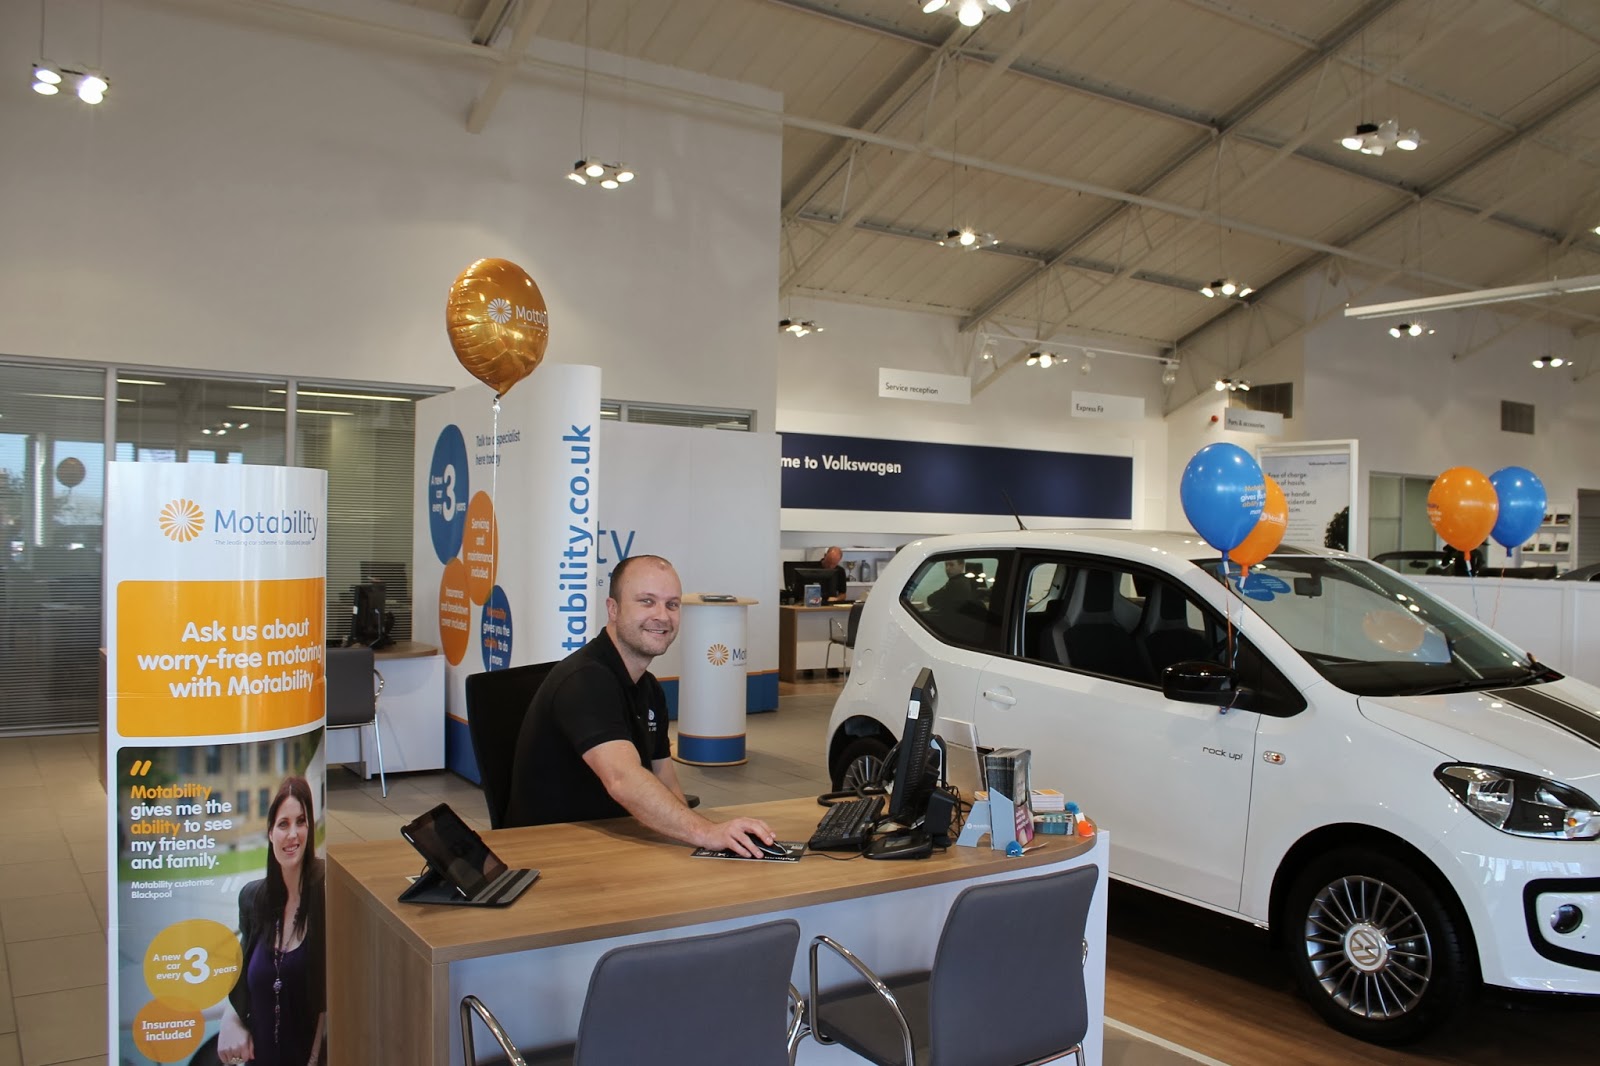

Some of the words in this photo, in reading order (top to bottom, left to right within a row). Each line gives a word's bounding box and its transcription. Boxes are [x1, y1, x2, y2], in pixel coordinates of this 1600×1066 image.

[885, 382, 908, 392] Service
[910, 386, 939, 395] reception
[1076, 403, 1096, 412] Express
[804, 456, 818, 469] to
[822, 455, 902, 476] Volkswagen
[443, 464, 456, 521] 3
[214, 509, 319, 541] Motability
[181, 620, 227, 643] Ask
[232, 625, 257, 641] us
[262, 618, 309, 640] about
[137, 647, 262, 675] worry-free
[267, 642, 322, 667] motoring
[169, 676, 221, 698] with
[227, 669, 314, 696] Motability
[1203, 746, 1226, 757] rock
[1228, 752, 1243, 761] up!
[130, 783, 213, 800] Motability
[130, 802, 172, 820] gives
[176, 804, 202, 816] me
[205, 799, 232, 814] the
[130, 820, 180, 836] ability
[184, 819, 201, 832] to
[204, 819, 232, 832] see
[131, 841, 156, 855] my
[159, 835, 216, 851] friends
[131, 855, 163, 869] and
[166, 852, 220, 869] family.
[131, 880, 173, 889] Motability
[131, 890, 172, 900] Blackpool
[183, 947, 210, 984] 3
[213, 965, 238, 976] years
[156, 972, 181, 980] every
[142, 1019, 196, 1030] Insurance
[146, 1029, 192, 1041] included
